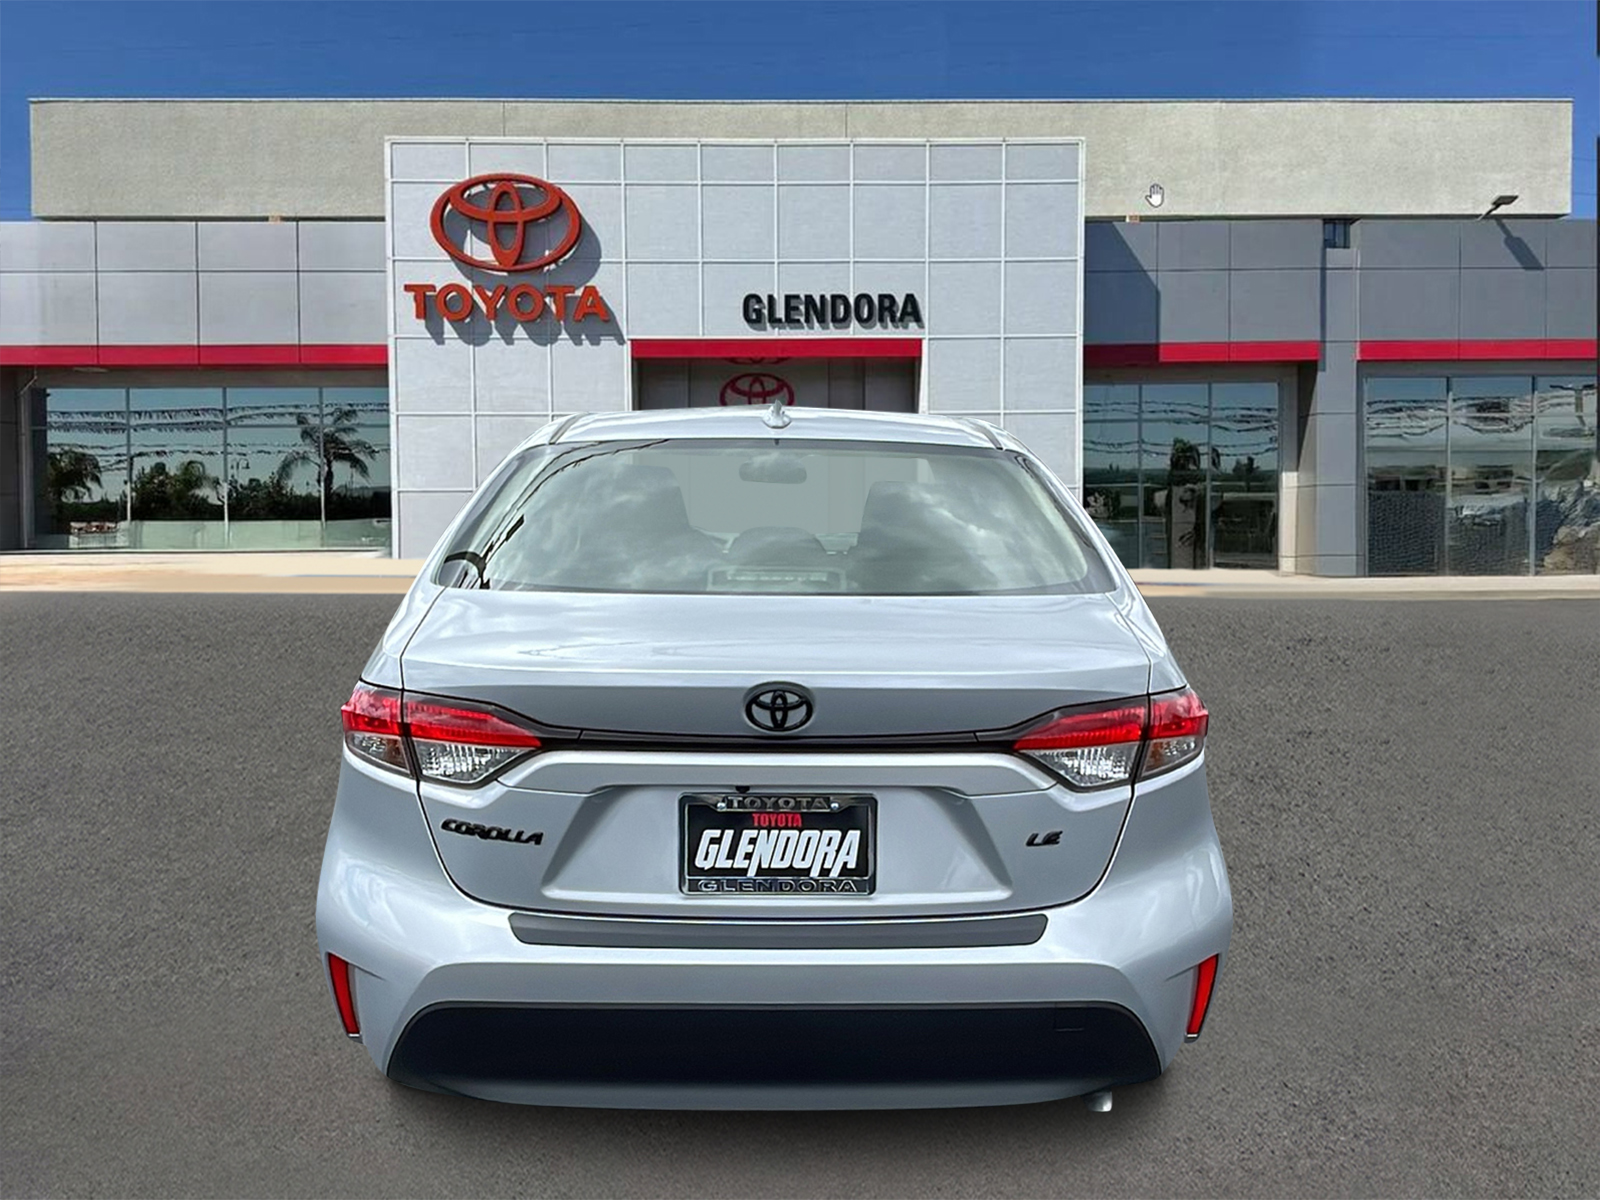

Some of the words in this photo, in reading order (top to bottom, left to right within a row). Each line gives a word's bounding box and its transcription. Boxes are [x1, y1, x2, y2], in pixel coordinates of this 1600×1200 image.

[404, 283, 610, 322] TOYOTA
[742, 293, 923, 325] GLENDORA
[727, 796, 829, 810] TOYOTA
[752, 813, 802, 827] TOYOTA
[441, 818, 544, 845] COROLLA
[1025, 830, 1063, 847] LE
[694, 829, 861, 878] GLENDORA
[697, 879, 858, 893] GLENDORA
